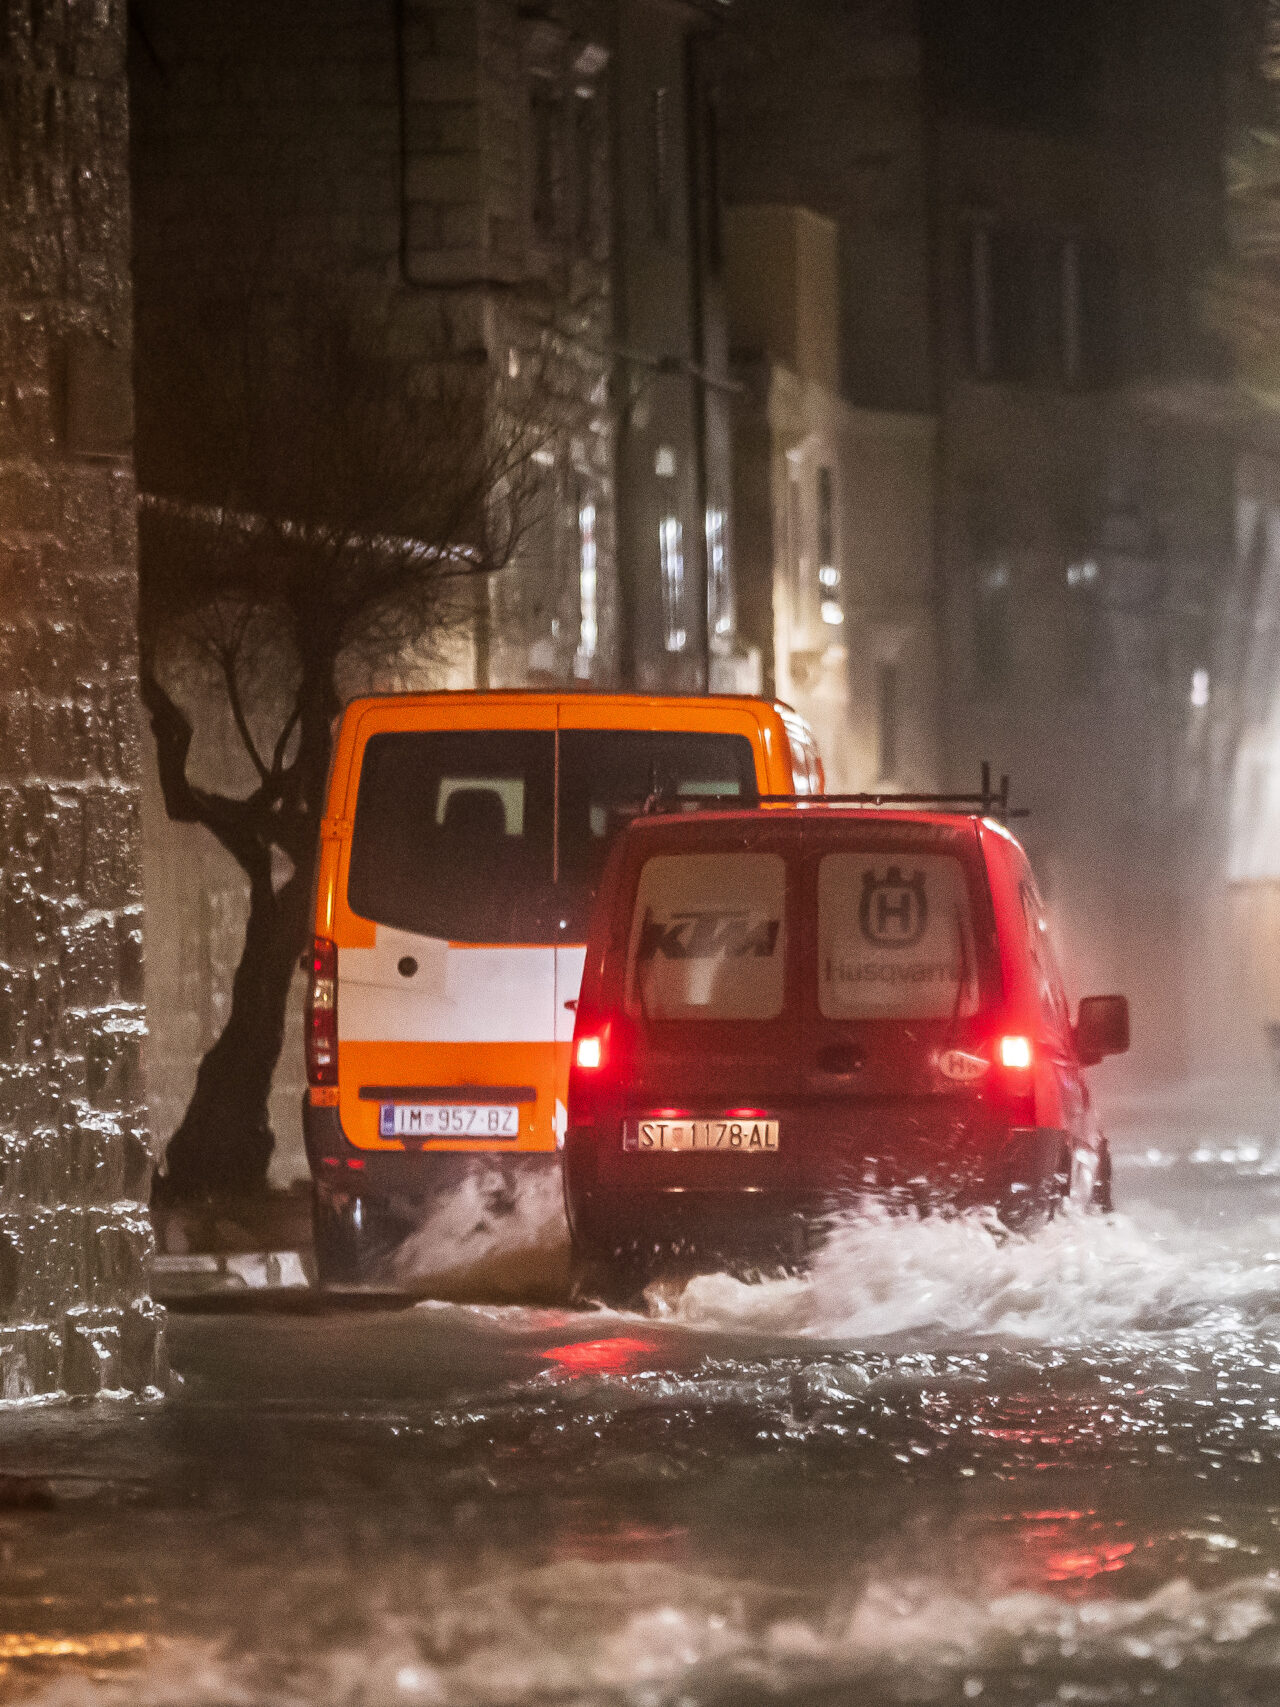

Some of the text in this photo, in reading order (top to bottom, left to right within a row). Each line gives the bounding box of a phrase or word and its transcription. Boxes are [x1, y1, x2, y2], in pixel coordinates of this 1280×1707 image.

[638, 913, 780, 959] KTM
[400, 1108, 422, 1131] IM
[642, 1123, 775, 1147] ST 1178-AL
